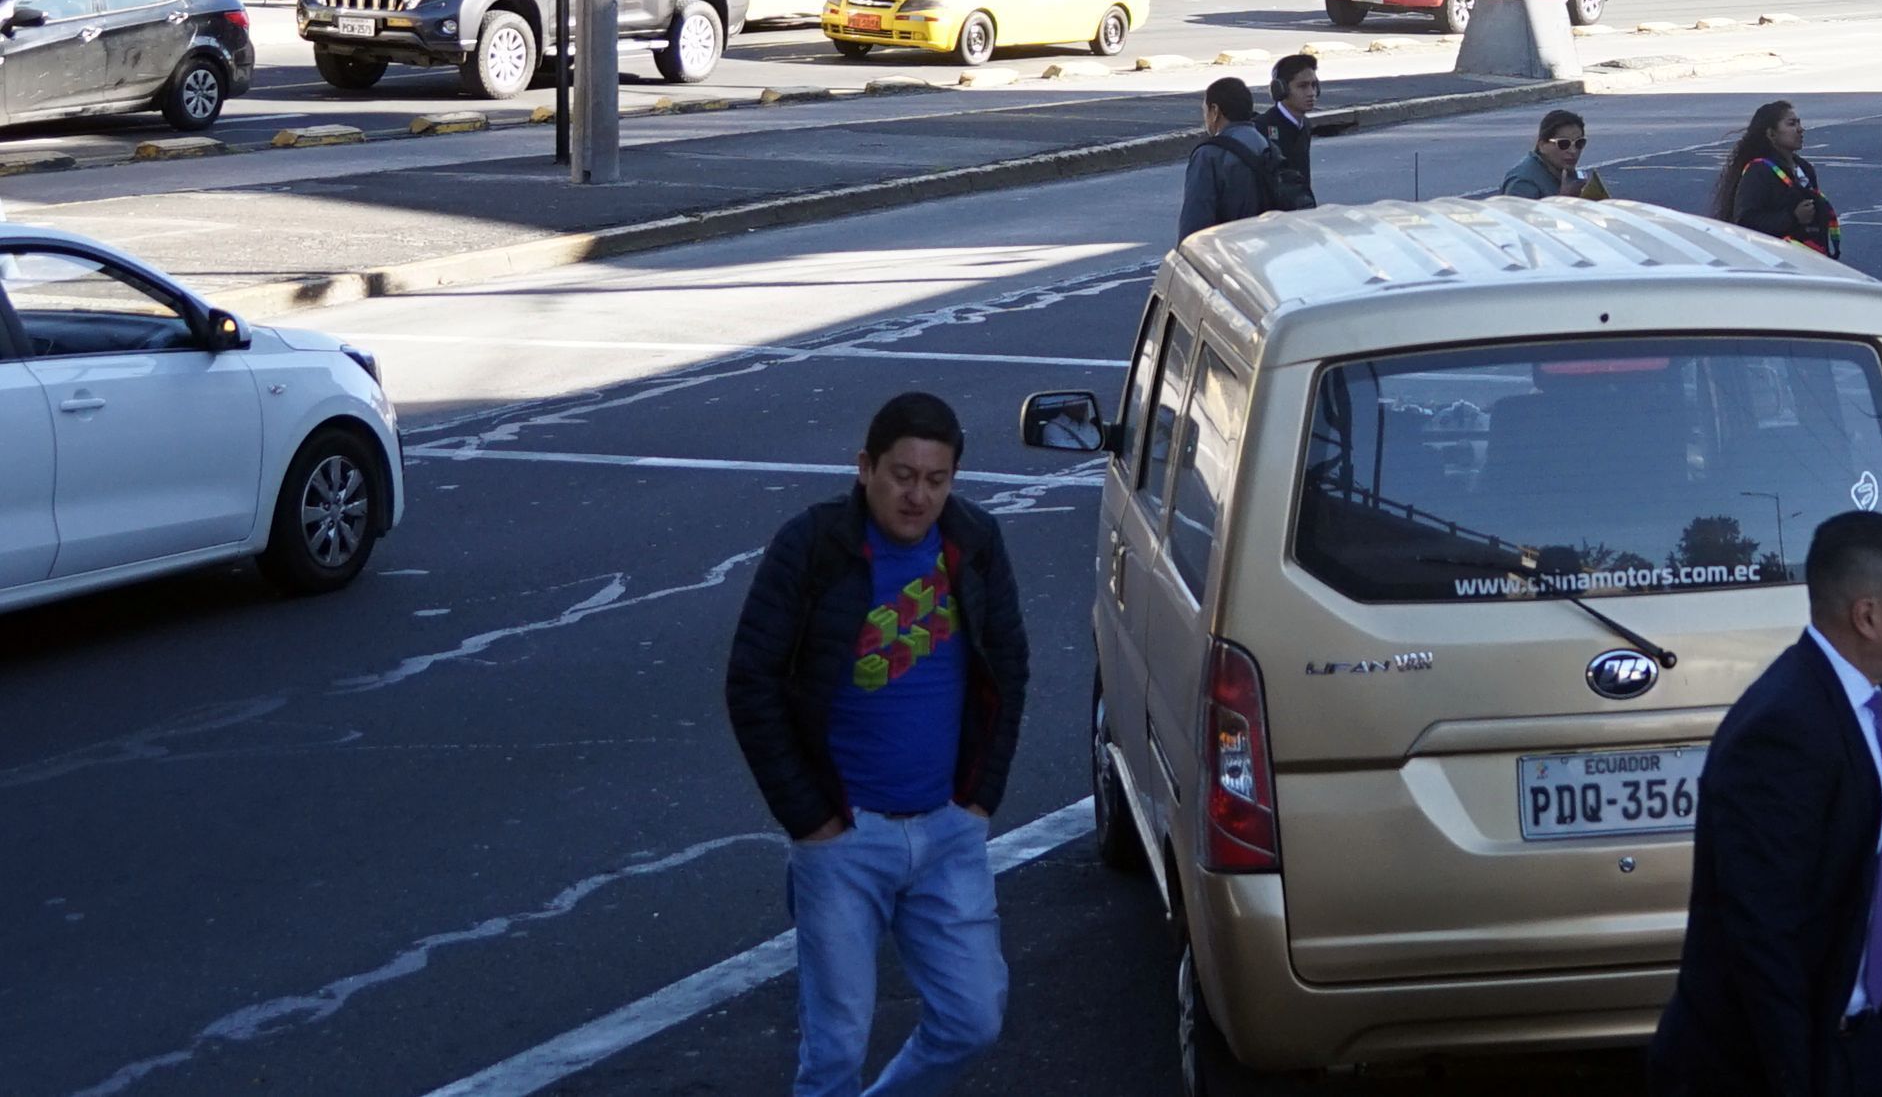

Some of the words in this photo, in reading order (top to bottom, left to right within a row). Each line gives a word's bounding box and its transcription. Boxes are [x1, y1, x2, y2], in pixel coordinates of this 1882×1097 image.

[1454, 564, 1761, 597] www.chinamotors.com.ec
[1584, 755, 1661, 776] ECUADOR
[1529, 776, 1703, 827] PDQ-356
